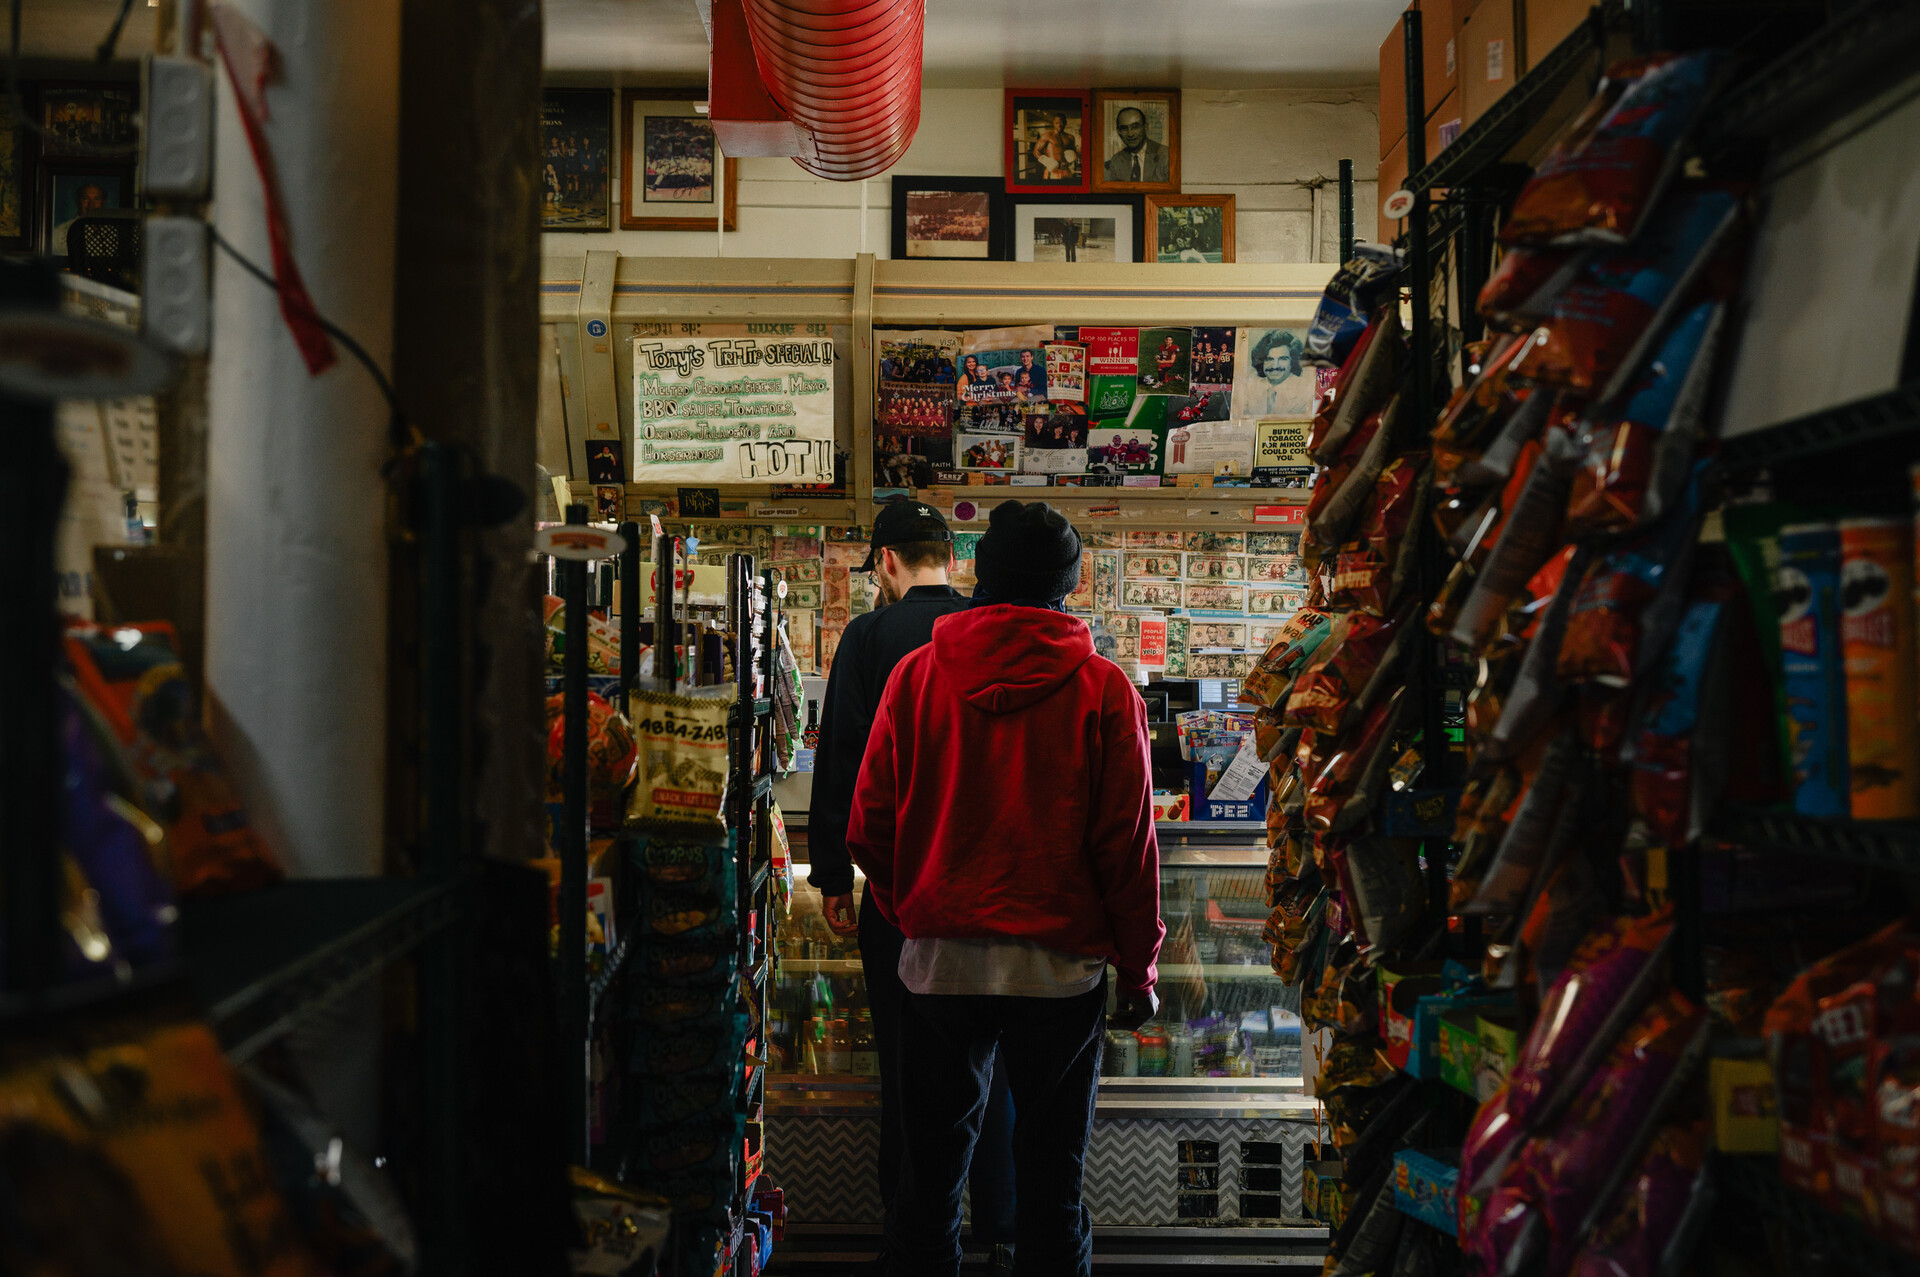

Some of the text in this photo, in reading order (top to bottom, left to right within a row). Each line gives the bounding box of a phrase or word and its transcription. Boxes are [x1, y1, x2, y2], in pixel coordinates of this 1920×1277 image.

[642, 377, 690, 397] MELTED
[789, 375, 831, 394] MAYO,
[964, 384, 997, 394] Merry
[961, 389, 1017, 402] Christmas
[642, 398, 797, 419] BBQ SAUCE, TOMATOES,
[642, 423, 694, 441] ONIONS,
[767, 425, 796, 439] AND
[642, 443, 724, 462] HORSERADISH
[1112, 452, 1126, 465] 43
[936, 472, 965, 481] PEREZ
[1142, 648, 1157, 656] yelp
[640, 718, 727, 742] ABBA-ZAB
[1192, 738, 1207, 747] PE
[1210, 802, 1251, 818] PEZ
